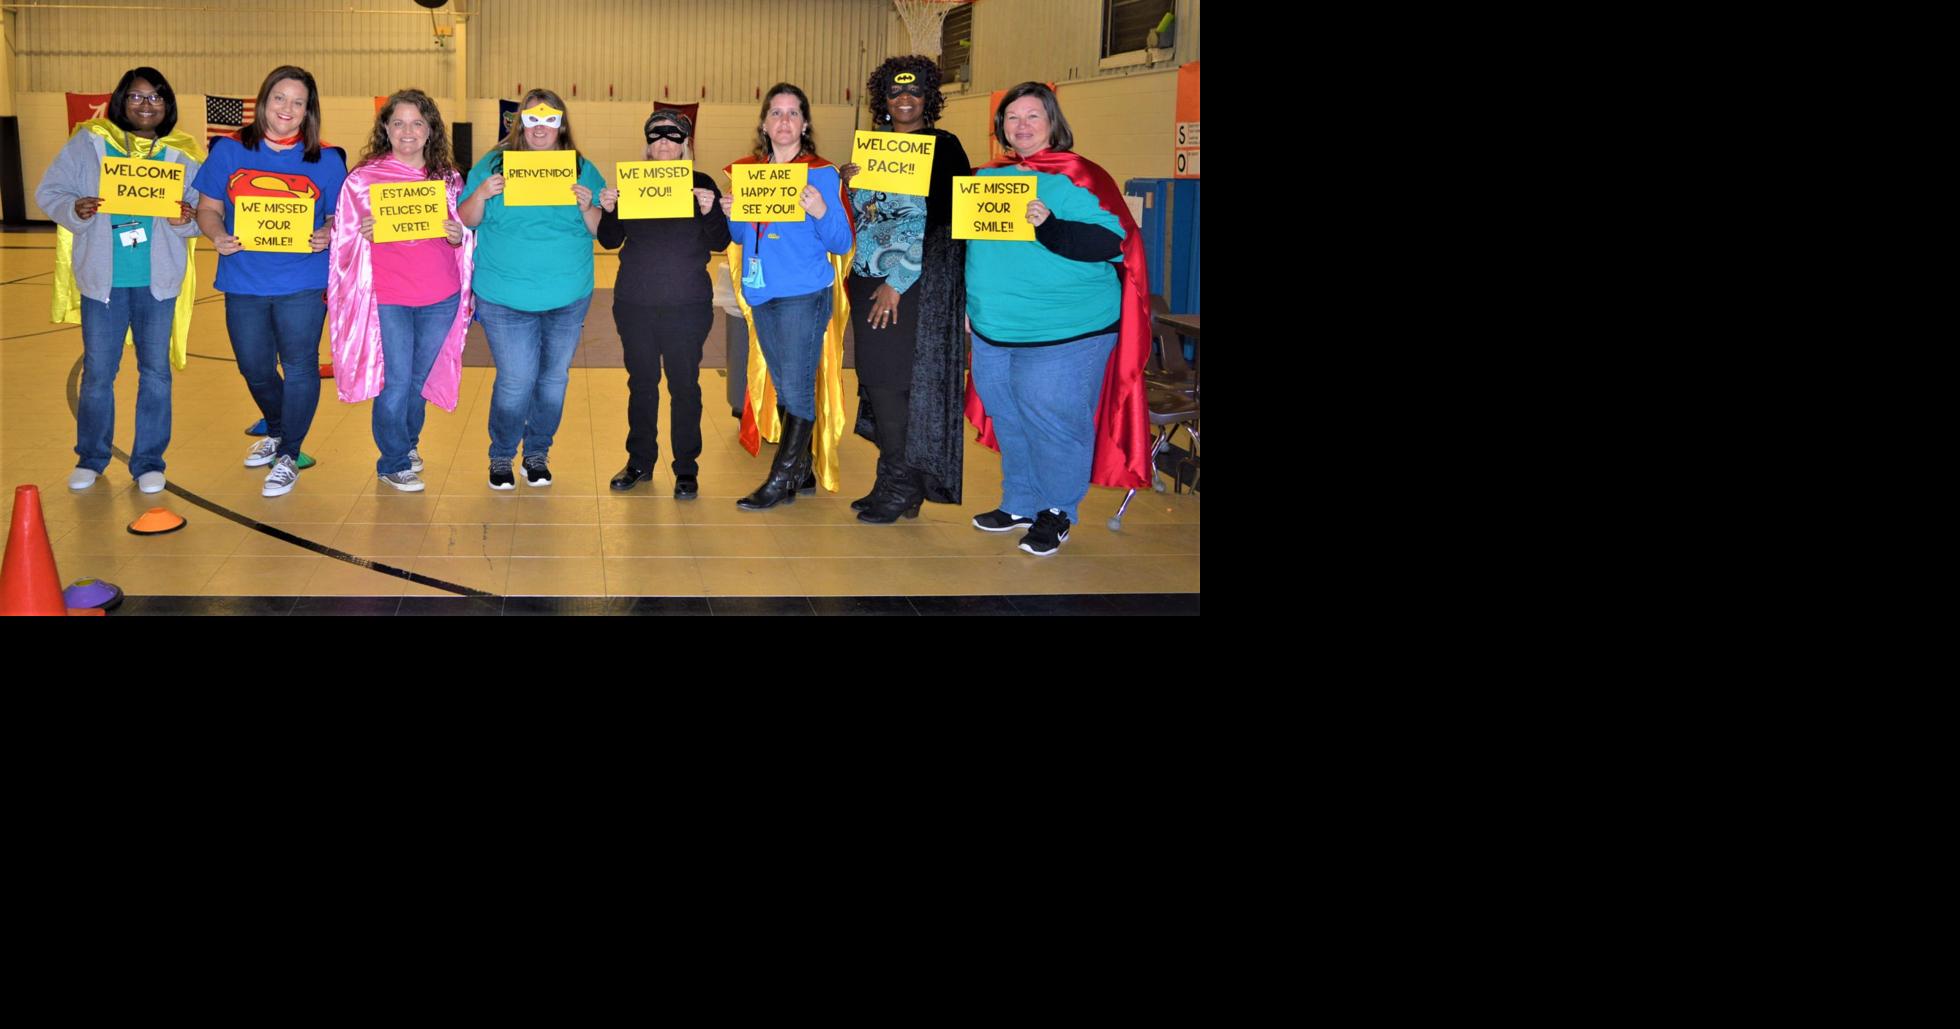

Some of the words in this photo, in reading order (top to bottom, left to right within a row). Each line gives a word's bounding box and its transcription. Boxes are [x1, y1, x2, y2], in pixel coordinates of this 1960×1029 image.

[1178, 125, 1186, 145] S
[857, 137, 932, 155] WELCOME
[104, 163, 182, 181] WELCOME
[868, 159, 915, 175] BACK!!
[619, 168, 640, 179] WE
[644, 167, 690, 178] MISSED
[748, 169, 766, 180] WE
[770, 169, 791, 180] ARE
[117, 184, 165, 199] BACK!!
[638, 186, 671, 197] YOU!!
[741, 187, 776, 197] HAPPY
[780, 186, 797, 197] TO
[960, 183, 980, 194] WE
[984, 183, 1030, 194] MISSED
[242, 202, 261, 213] WE
[265, 203, 308, 214] MISSED
[380, 205, 422, 216] FELICES
[425, 204, 438, 213] DE
[742, 204, 762, 214] SEE
[765, 204, 795, 214] YOU!!
[977, 202, 1010, 213] YOUR
[257, 220, 291, 231] YOUR
[392, 221, 430, 232] VERTE!
[973, 221, 1014, 232] SMILE!!
[254, 236, 293, 247] SMILE!!
